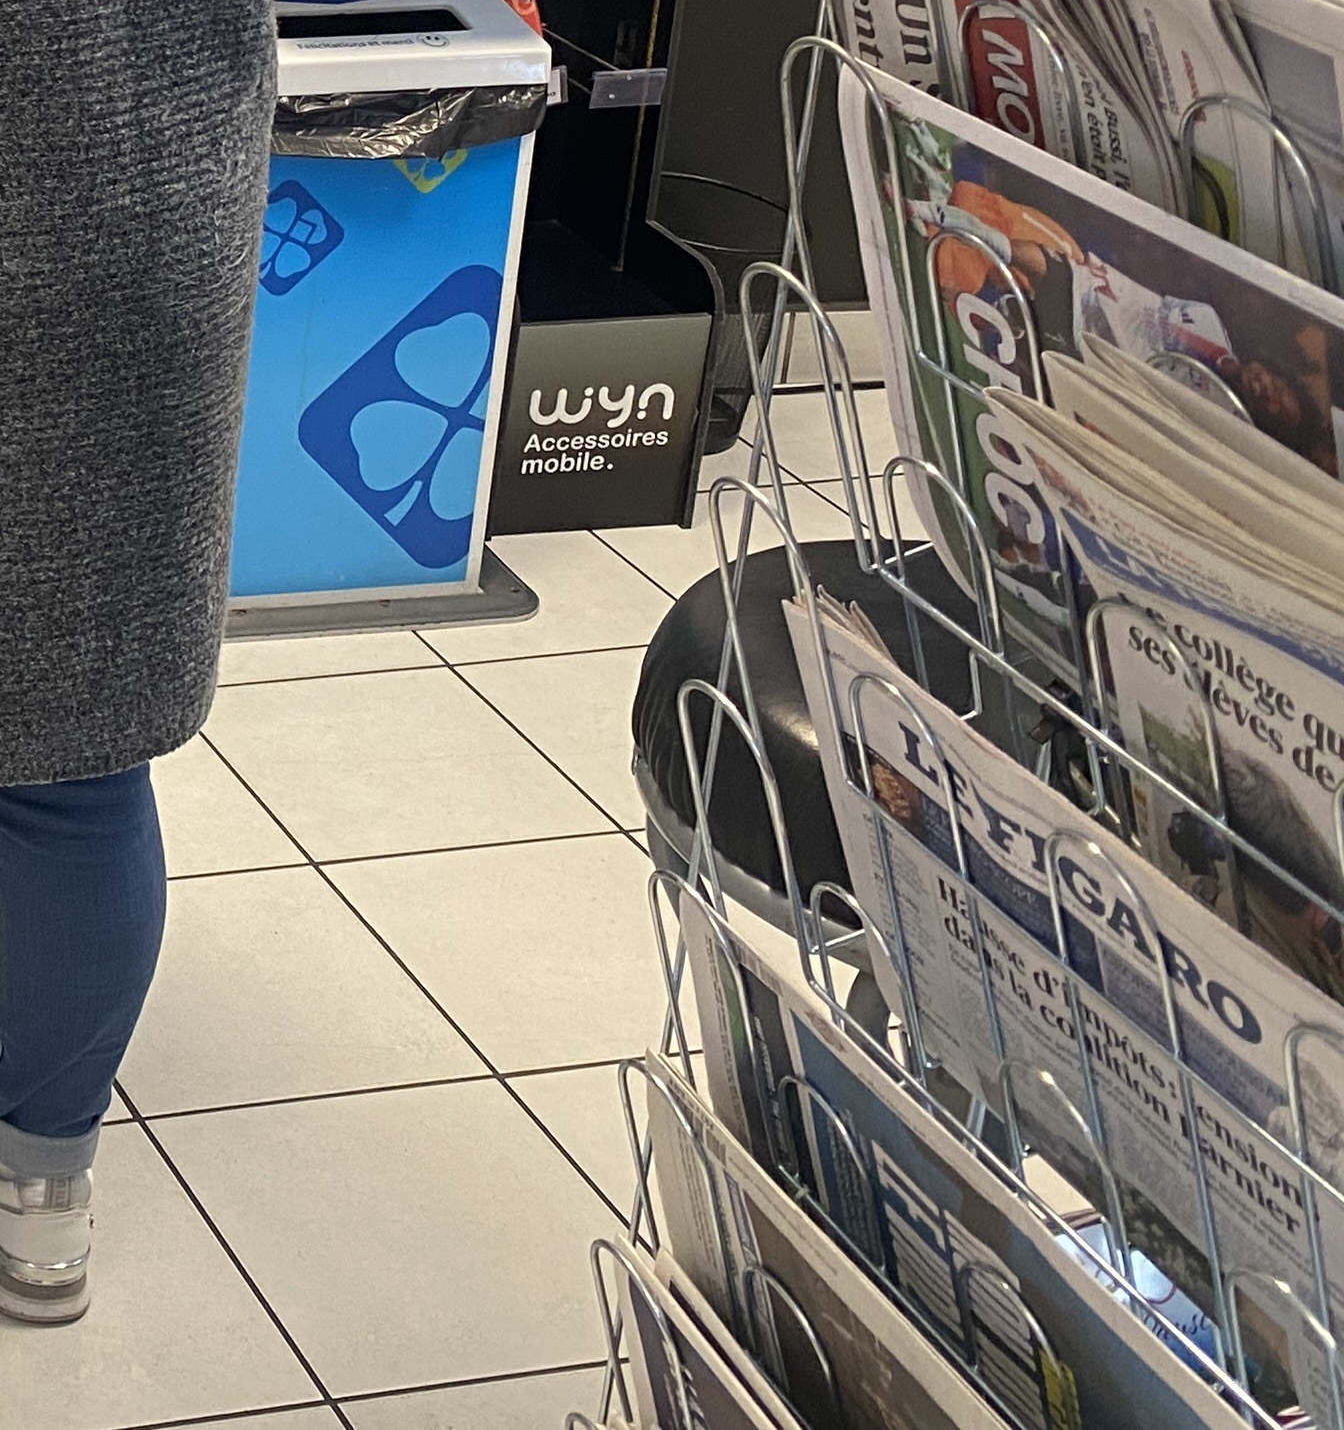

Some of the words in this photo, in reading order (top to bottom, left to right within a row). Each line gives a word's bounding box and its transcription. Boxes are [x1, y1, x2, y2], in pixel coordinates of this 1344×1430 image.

[523, 428, 669, 453] Accessoires
[528, 382, 675, 428] wyn
[520, 450, 614, 475] mobile.
[1127, 625, 1177, 676] ses
[1292, 744, 1336, 793] de
[1174, 622, 1296, 722] collège
[975, 797, 1263, 1046] FIGARO
[1039, 1003, 1171, 1127] colition
[1192, 1103, 1304, 1209] ension
